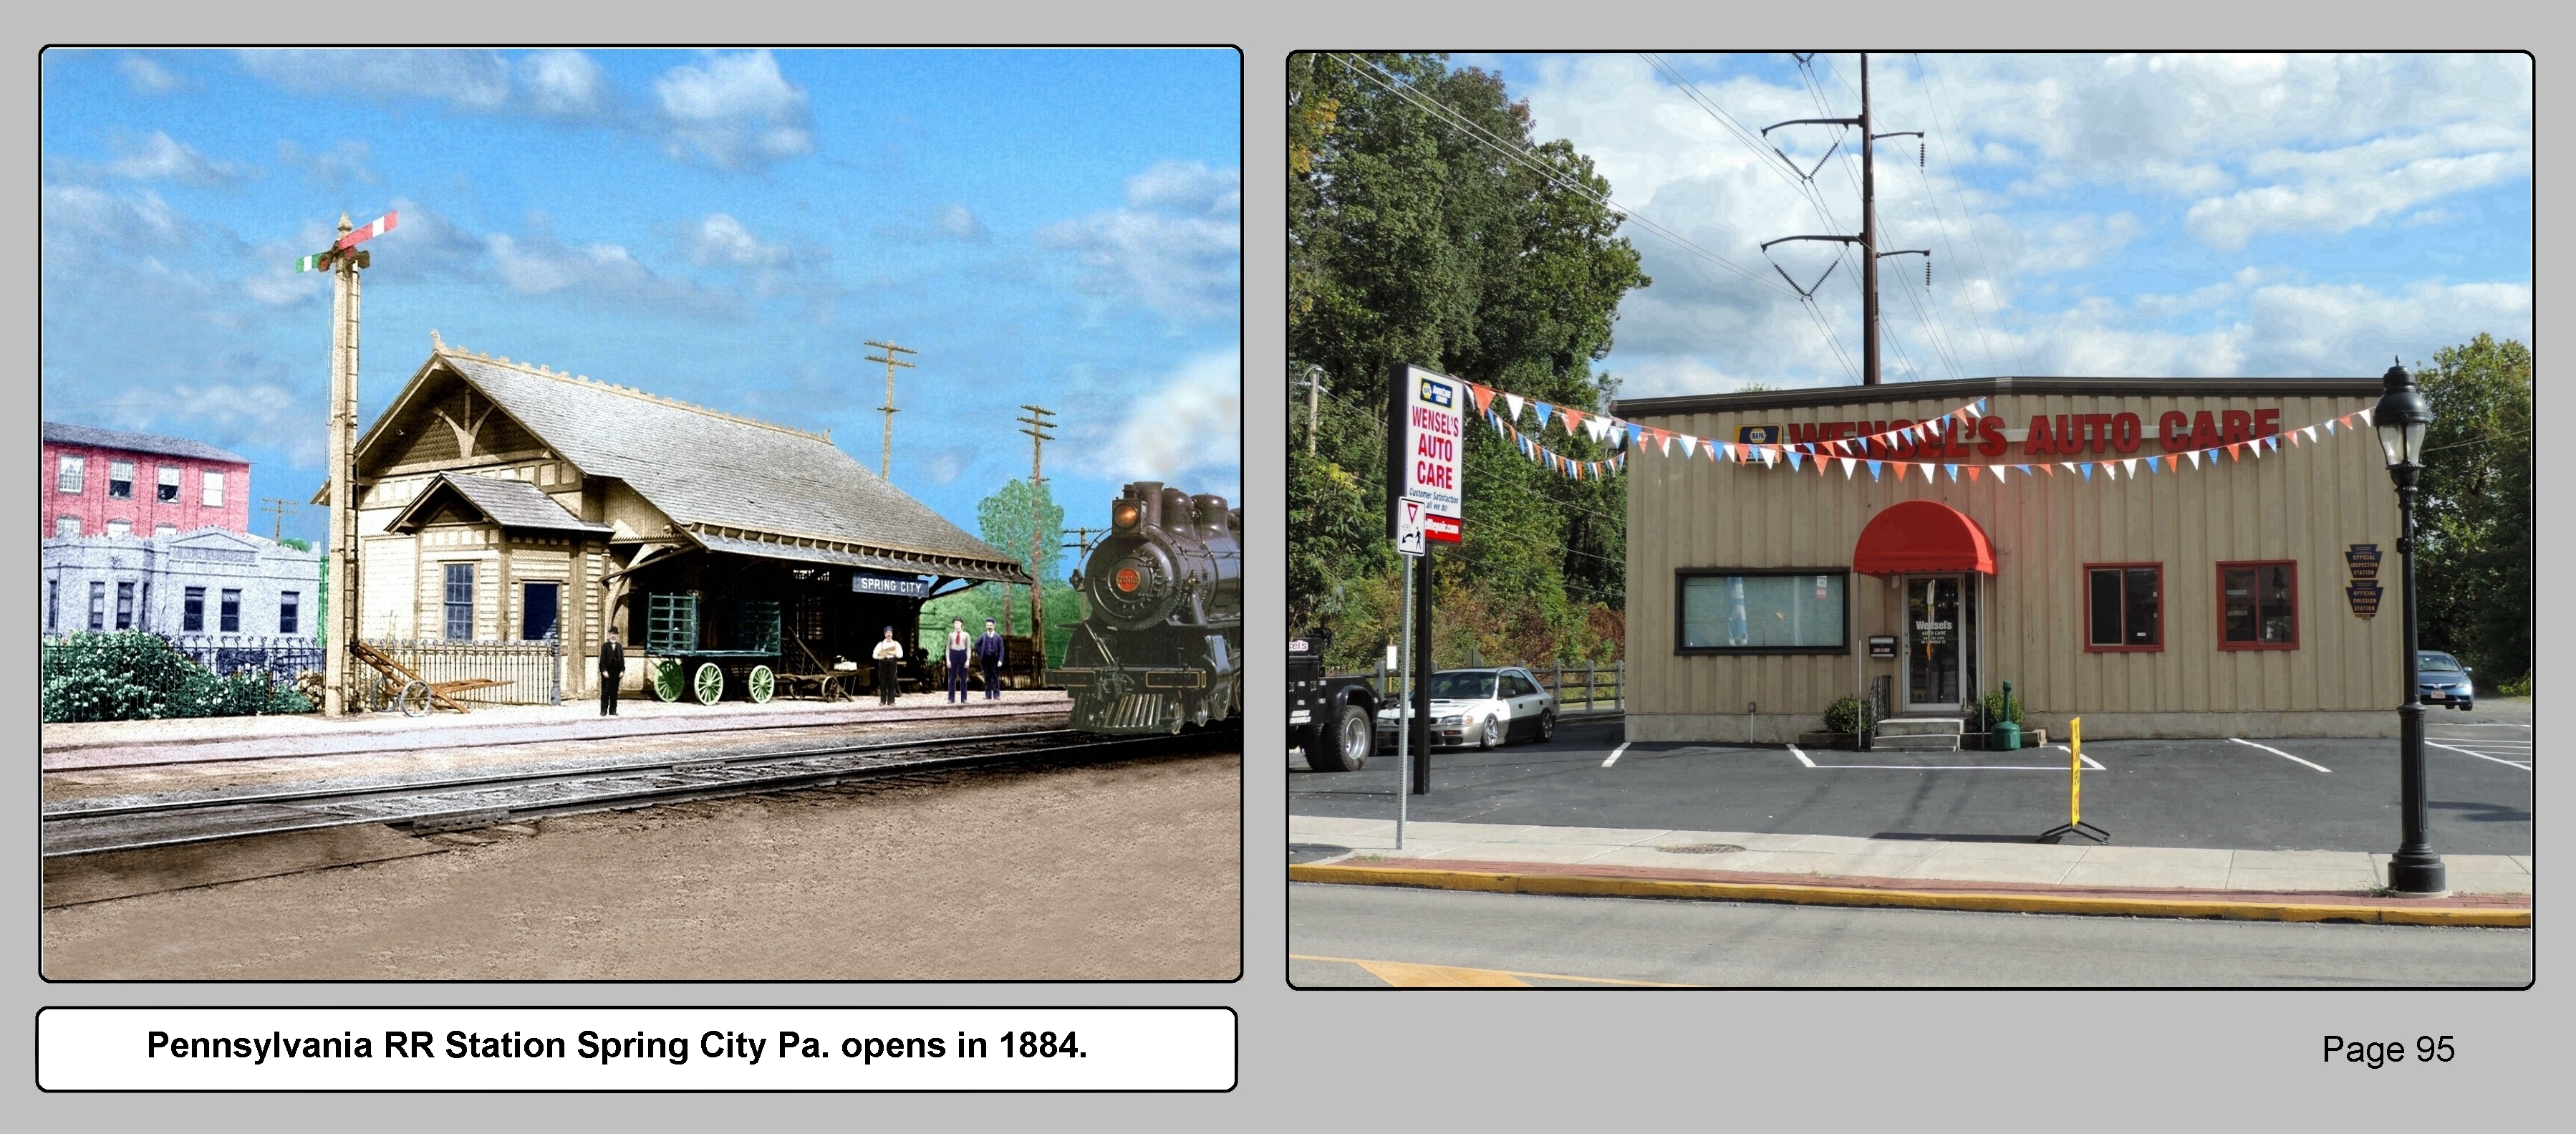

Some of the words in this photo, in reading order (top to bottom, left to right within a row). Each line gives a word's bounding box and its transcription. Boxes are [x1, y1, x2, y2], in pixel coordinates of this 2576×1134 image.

[1412, 405, 1459, 438] WENSEL'S
[1788, 416, 2006, 462] WENSEL'S
[2024, 412, 2141, 455] AUTO
[2159, 408, 2281, 453] CARE
[1418, 433, 1452, 462] AUTO
[1417, 460, 1452, 490] CARE
[1409, 487, 1432, 499] Customer
[1433, 492, 1459, 504] Satisfaction
[861, 577, 897, 591] SPRING
[1916, 620, 1952, 630] Wensel's
